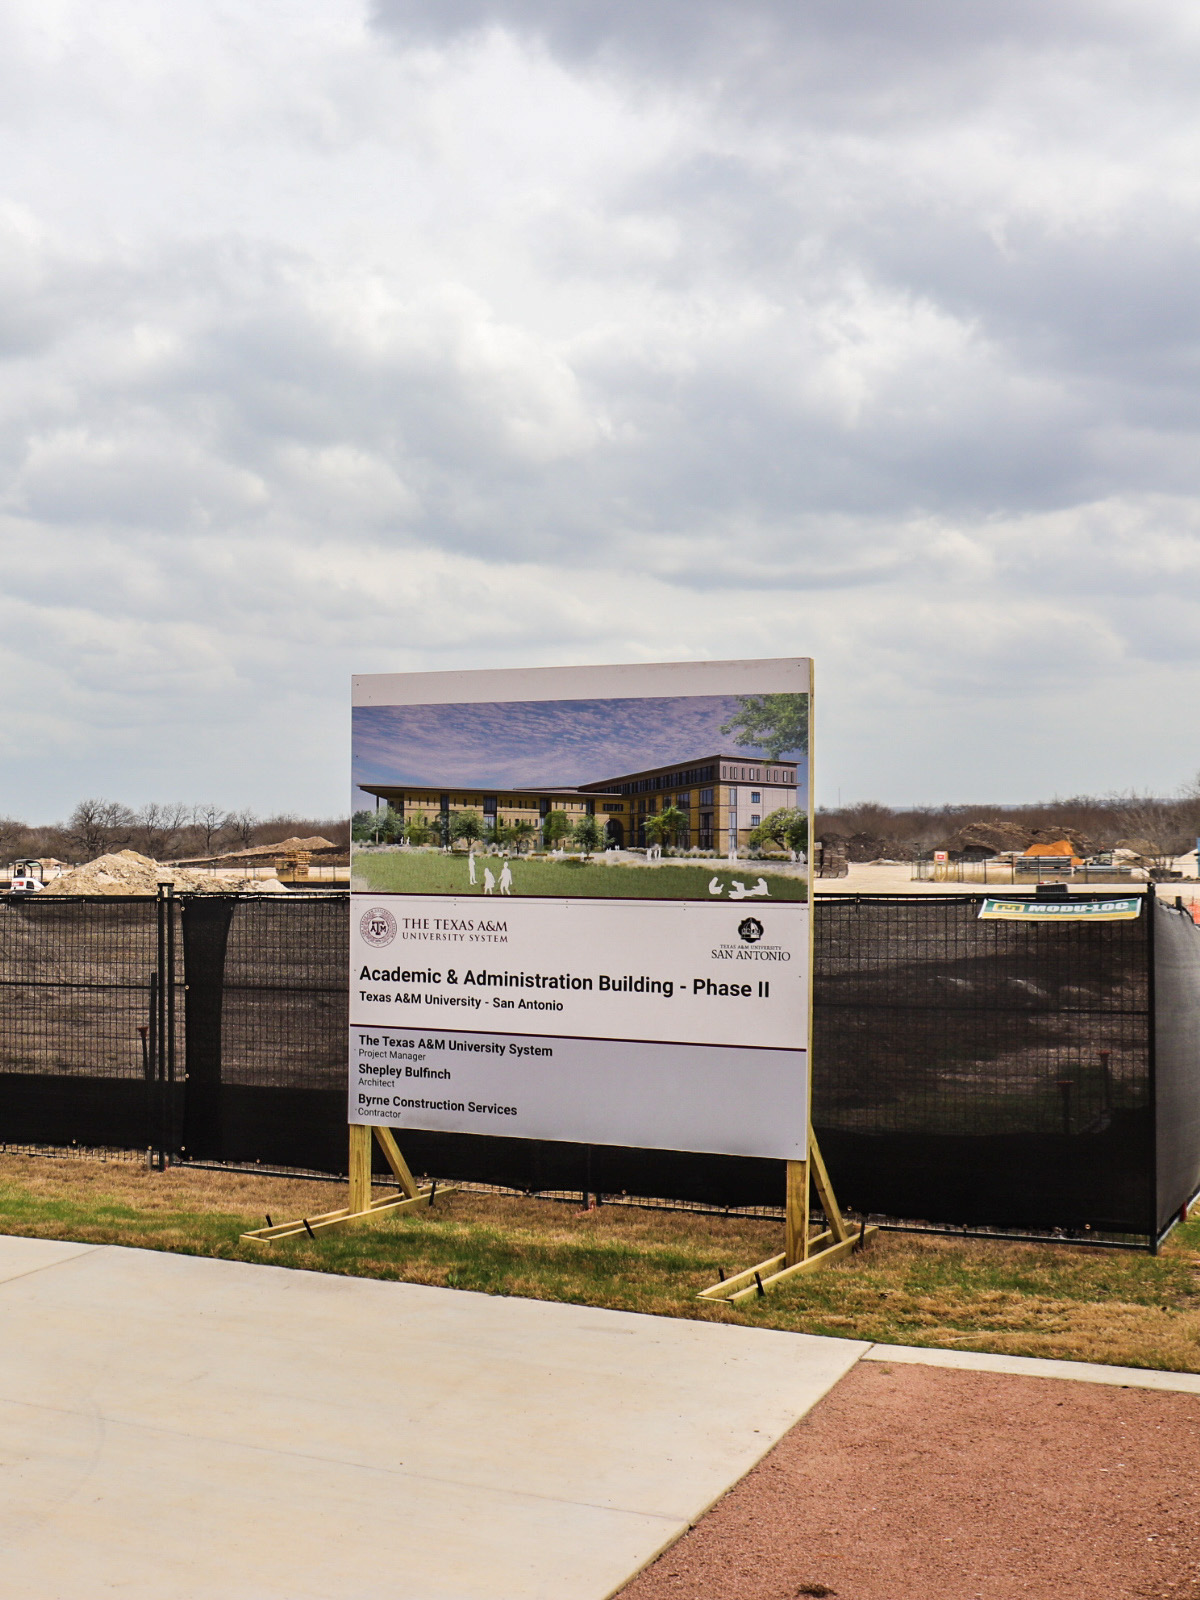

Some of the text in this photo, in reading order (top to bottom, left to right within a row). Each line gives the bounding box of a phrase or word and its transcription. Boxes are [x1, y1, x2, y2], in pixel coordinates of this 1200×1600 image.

[1028, 902, 1129, 913] MODU-LOC
[402, 918, 508, 932] THE TEXAS A&M
[402, 932, 508, 943] UNIVERSITY SYSTEM
[711, 949, 791, 961] SAN ANTONIO
[359, 966, 442, 984] Academic
[446, 968, 458, 984] &
[464, 970, 593, 990] Administration
[599, 975, 674, 998] Building
[693, 978, 752, 997] Phase
[758, 981, 770, 997] II
[359, 991, 392, 1002] Texas
[394, 992, 421, 1004] A&M
[424, 994, 481, 1009] University
[493, 997, 515, 1009] San
[518, 998, 564, 1011] Antonio
[359, 1035, 553, 1057] The Texas A&M University System
[359, 1049, 426, 1062] Project Manager
[358, 1064, 451, 1080] Shepley Bulfinch
[358, 1078, 395, 1088] Architect
[358, 1094, 517, 1116] Byrne Construction Services
[358, 1108, 401, 1118] Contractor
